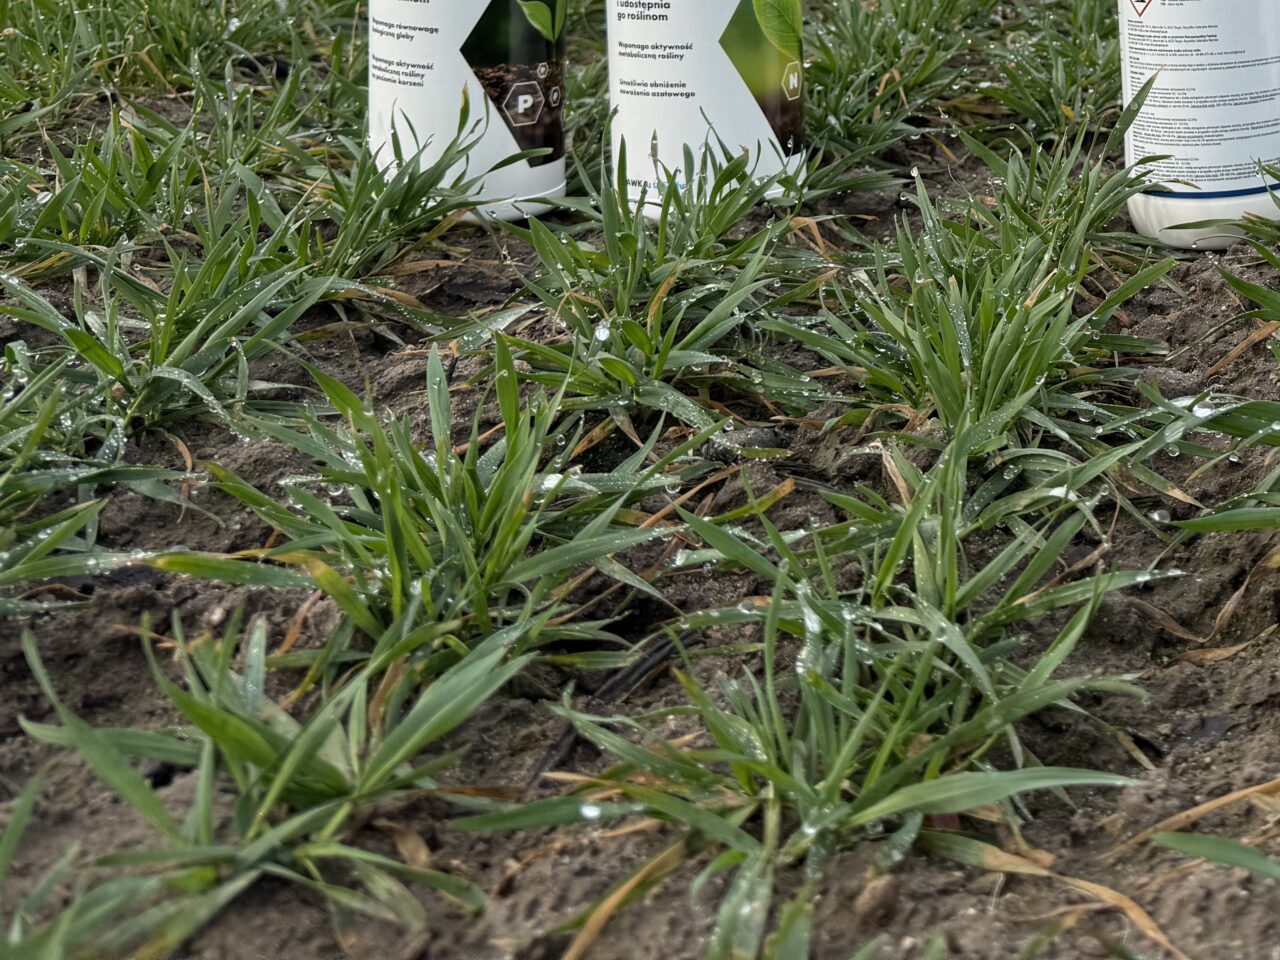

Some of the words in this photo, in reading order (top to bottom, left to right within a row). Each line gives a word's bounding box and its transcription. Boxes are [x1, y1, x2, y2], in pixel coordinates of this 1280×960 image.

[617, 12, 626, 21] go
[627, 10, 669, 21] roślinom
[650, 42, 693, 52] aktywność
[658, 51, 685, 61] rośliny
[789, 72, 798, 90] N
[518, 95, 534, 114] P
